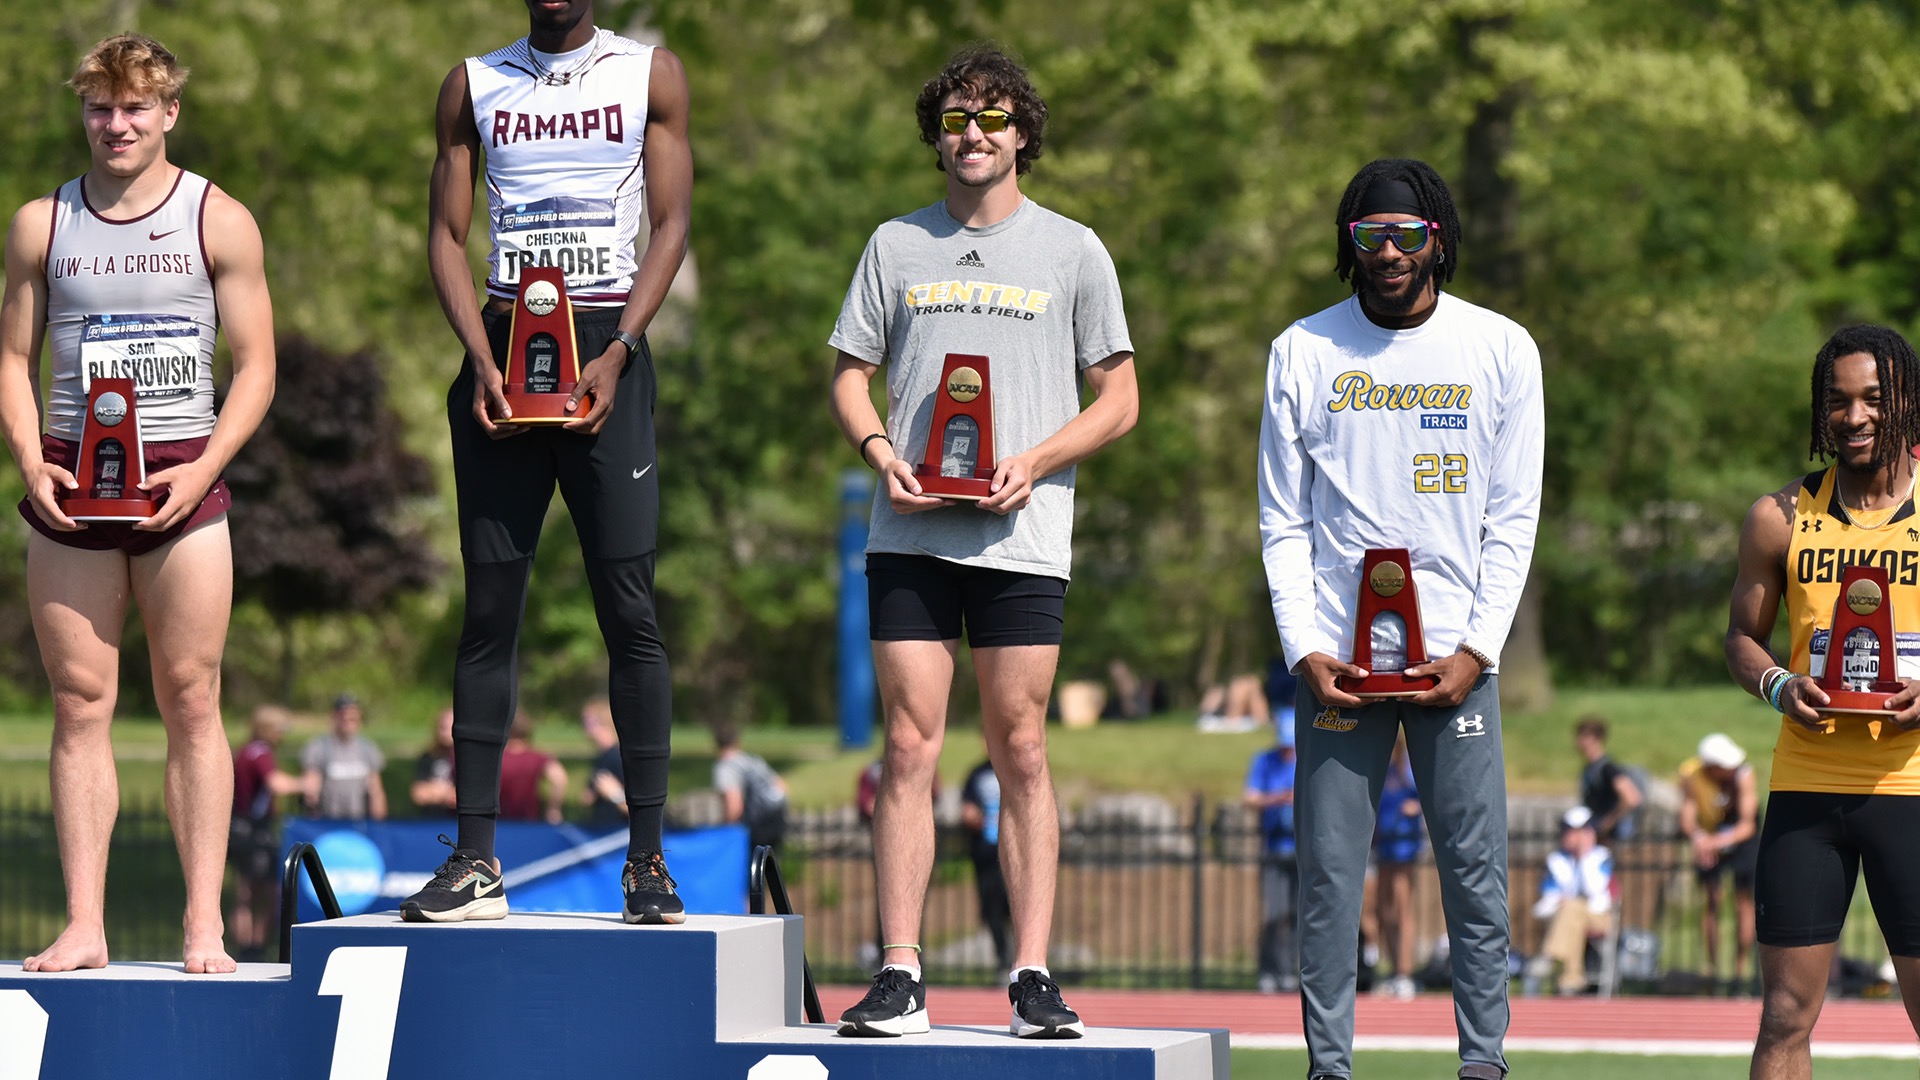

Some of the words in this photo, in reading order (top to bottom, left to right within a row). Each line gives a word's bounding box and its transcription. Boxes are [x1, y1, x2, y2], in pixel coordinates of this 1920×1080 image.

[492, 103, 623, 148] RAMAPO
[515, 215, 535, 223] TRACK
[540, 212, 557, 222] FIELD
[558, 212, 613, 221] CHAMPIONSHIPS
[526, 231, 587, 247] CHEICKNA
[54, 254, 116, 280] UW-LA
[124, 252, 195, 276] CROSSE
[504, 246, 611, 281] TRAORE
[955, 259, 985, 268] adidas
[527, 297, 557, 307] NCAA
[906, 280, 1052, 314] CENTRE
[915, 304, 966, 316] TRACK
[971, 305, 982, 314] &
[988, 306, 1035, 321] FIELD
[101, 325, 121, 334] TRACK
[126, 324, 143, 333] FIELD
[144, 322, 196, 332] CHAMPIONSHIPS
[128, 342, 156, 356] SAM
[89, 356, 197, 388] BLASKOWSKI
[949, 384, 980, 394] NCAA
[1327, 370, 1472, 413] Rowan
[1423, 416, 1466, 428] TRACK
[1413, 453, 1468, 493] 22
[317, 946, 408, 1080] 1
